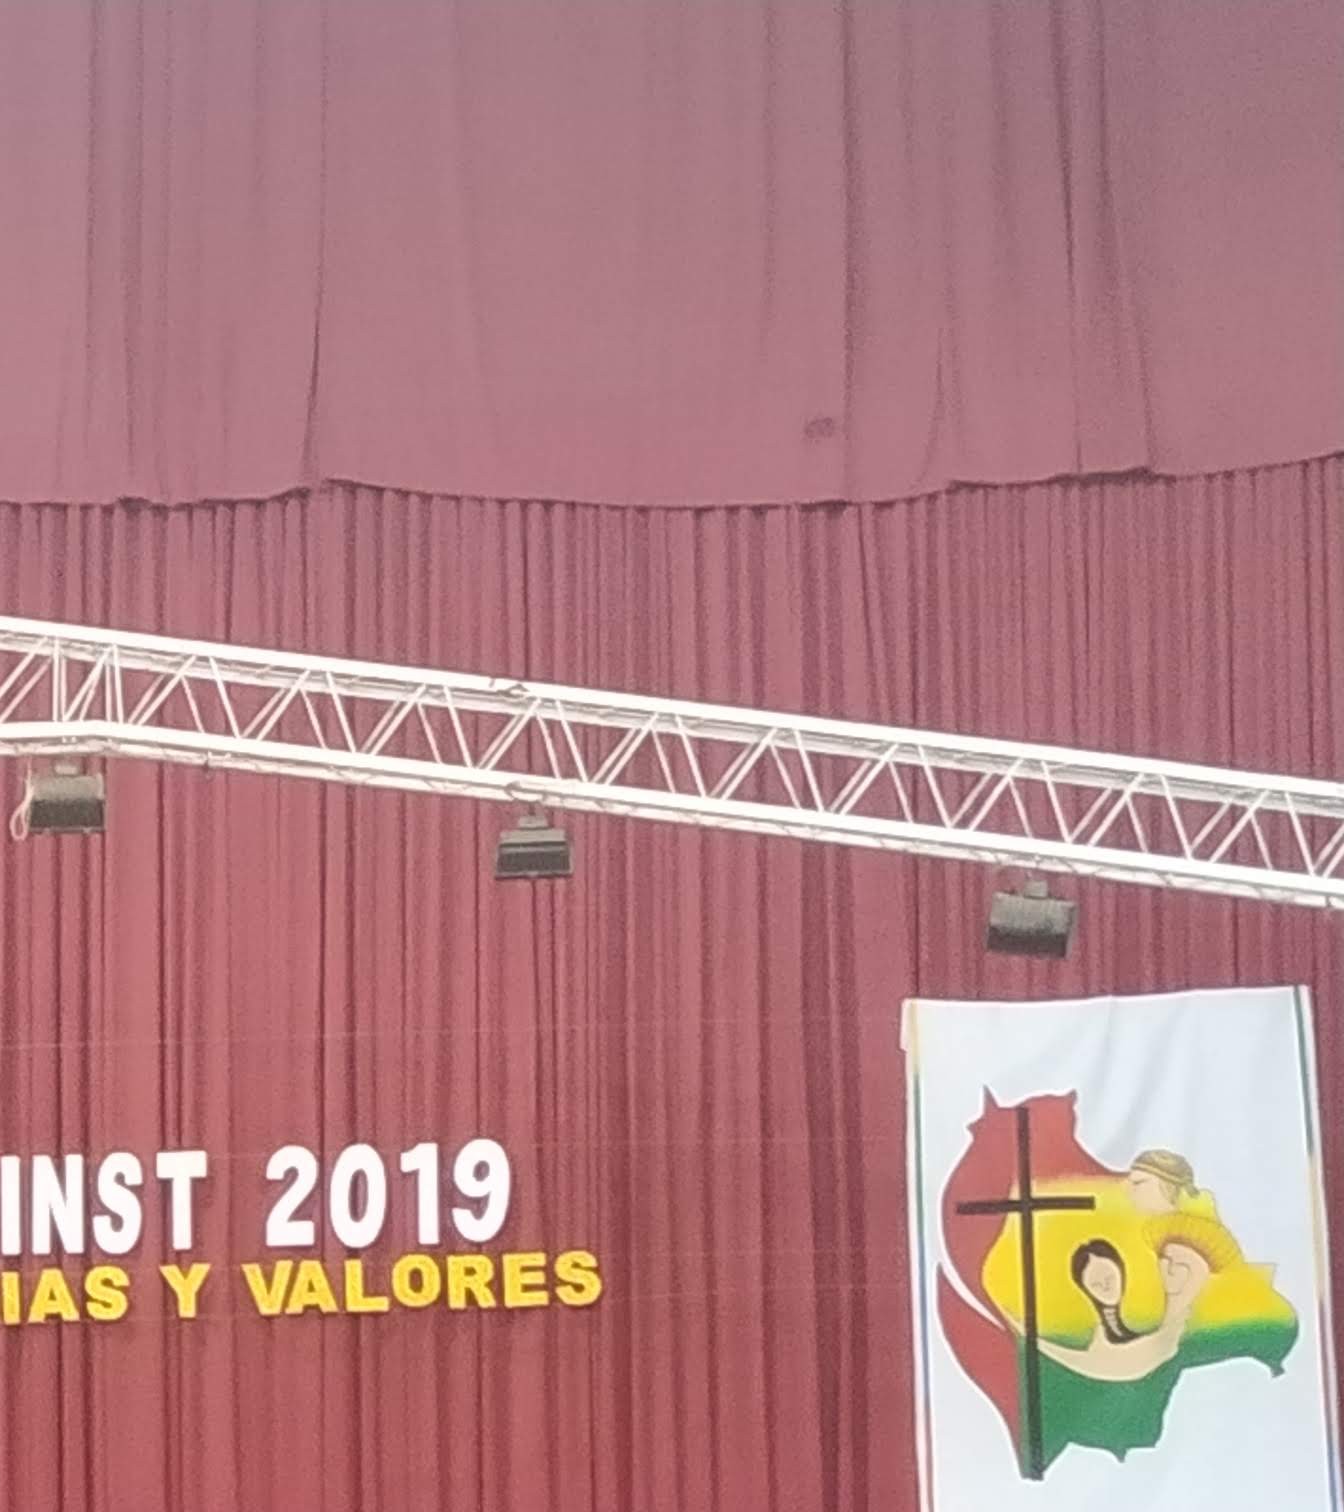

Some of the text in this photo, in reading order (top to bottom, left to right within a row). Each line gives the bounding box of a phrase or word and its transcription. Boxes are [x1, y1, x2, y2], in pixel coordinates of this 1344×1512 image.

[264, 1137, 512, 1249] 2019
[161, 1262, 211, 1319] Y
[242, 1249, 603, 1318] VALORES
